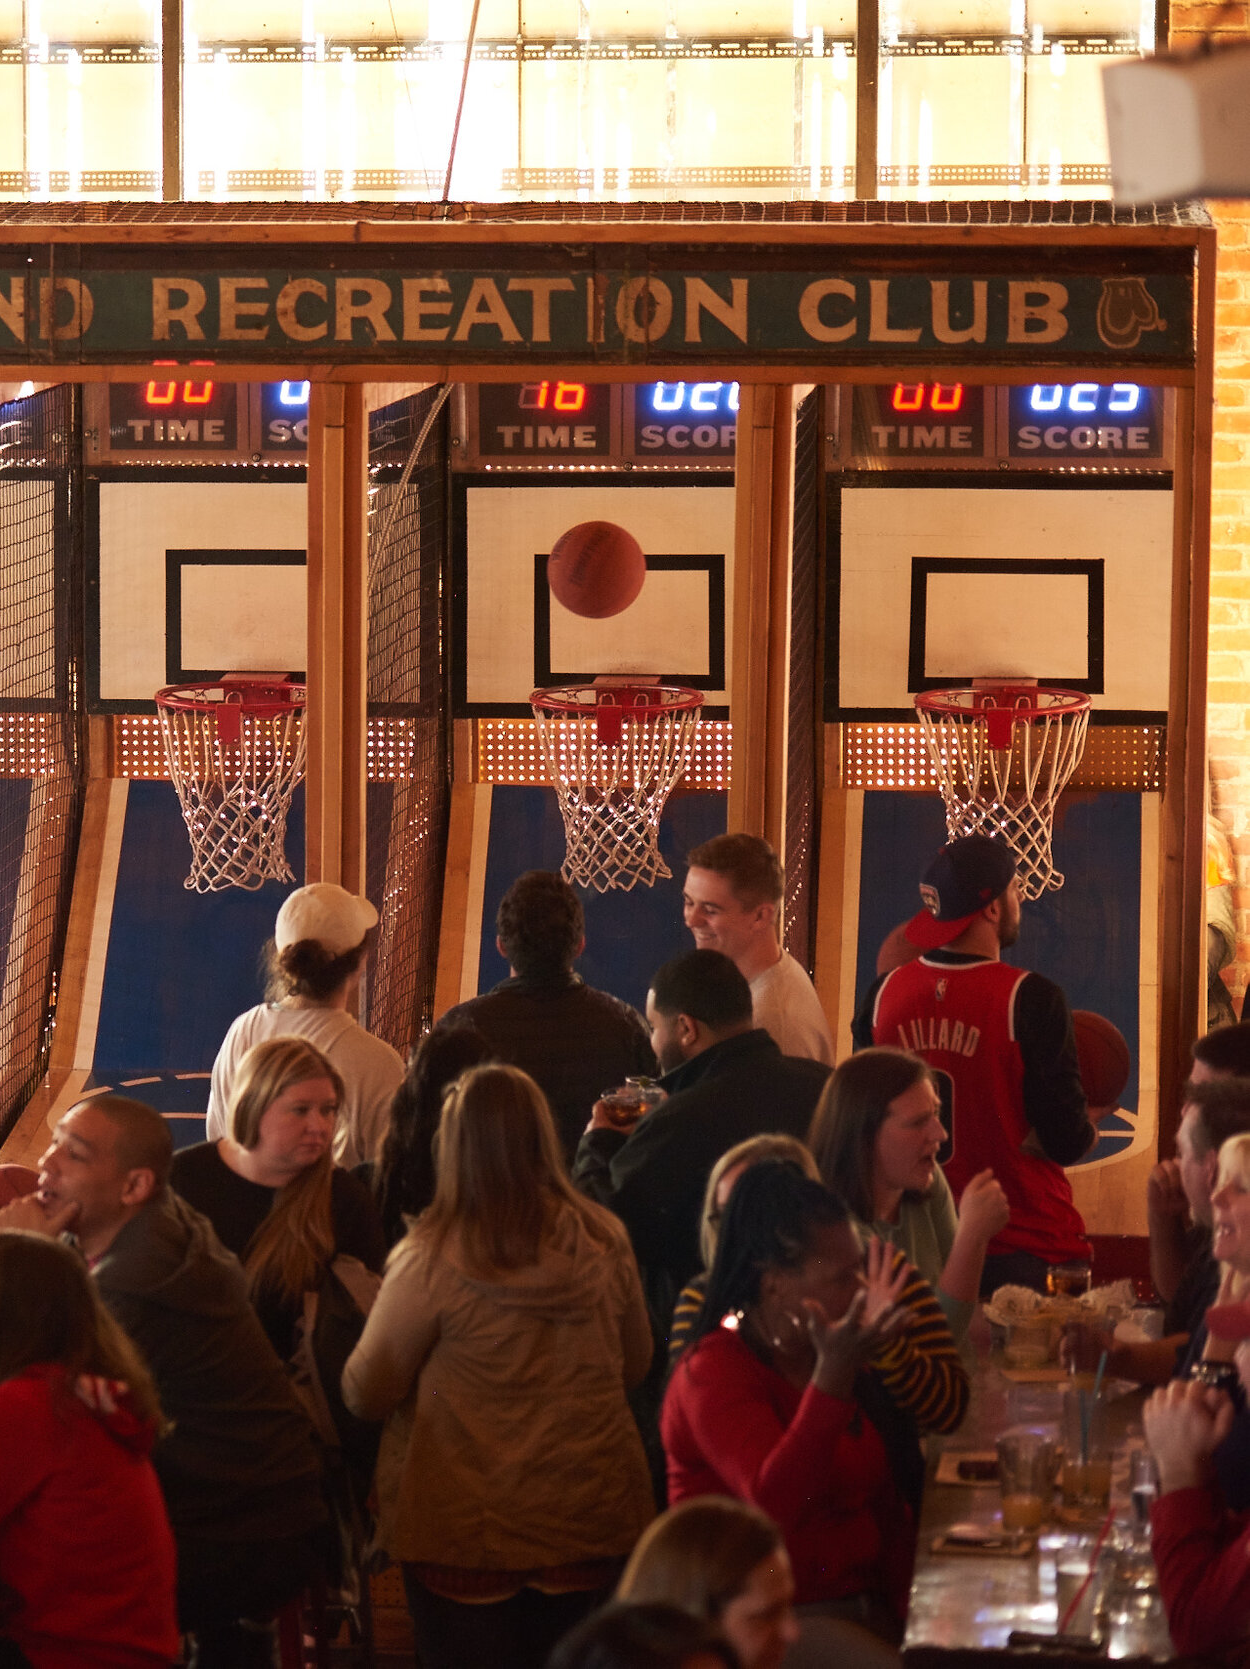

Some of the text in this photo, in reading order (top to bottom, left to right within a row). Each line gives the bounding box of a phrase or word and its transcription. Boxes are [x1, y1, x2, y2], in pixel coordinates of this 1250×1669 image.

[152, 276, 748, 343] RECREATION
[799, 278, 1069, 343] CLUB
[127, 419, 225, 442] TIME
[496, 425, 597, 448] TIME
[640, 425, 736, 448] SCOR
[871, 425, 973, 449] TIME
[1017, 425, 1150, 449] SCORE
[897, 1017, 981, 1058] LILLARD
